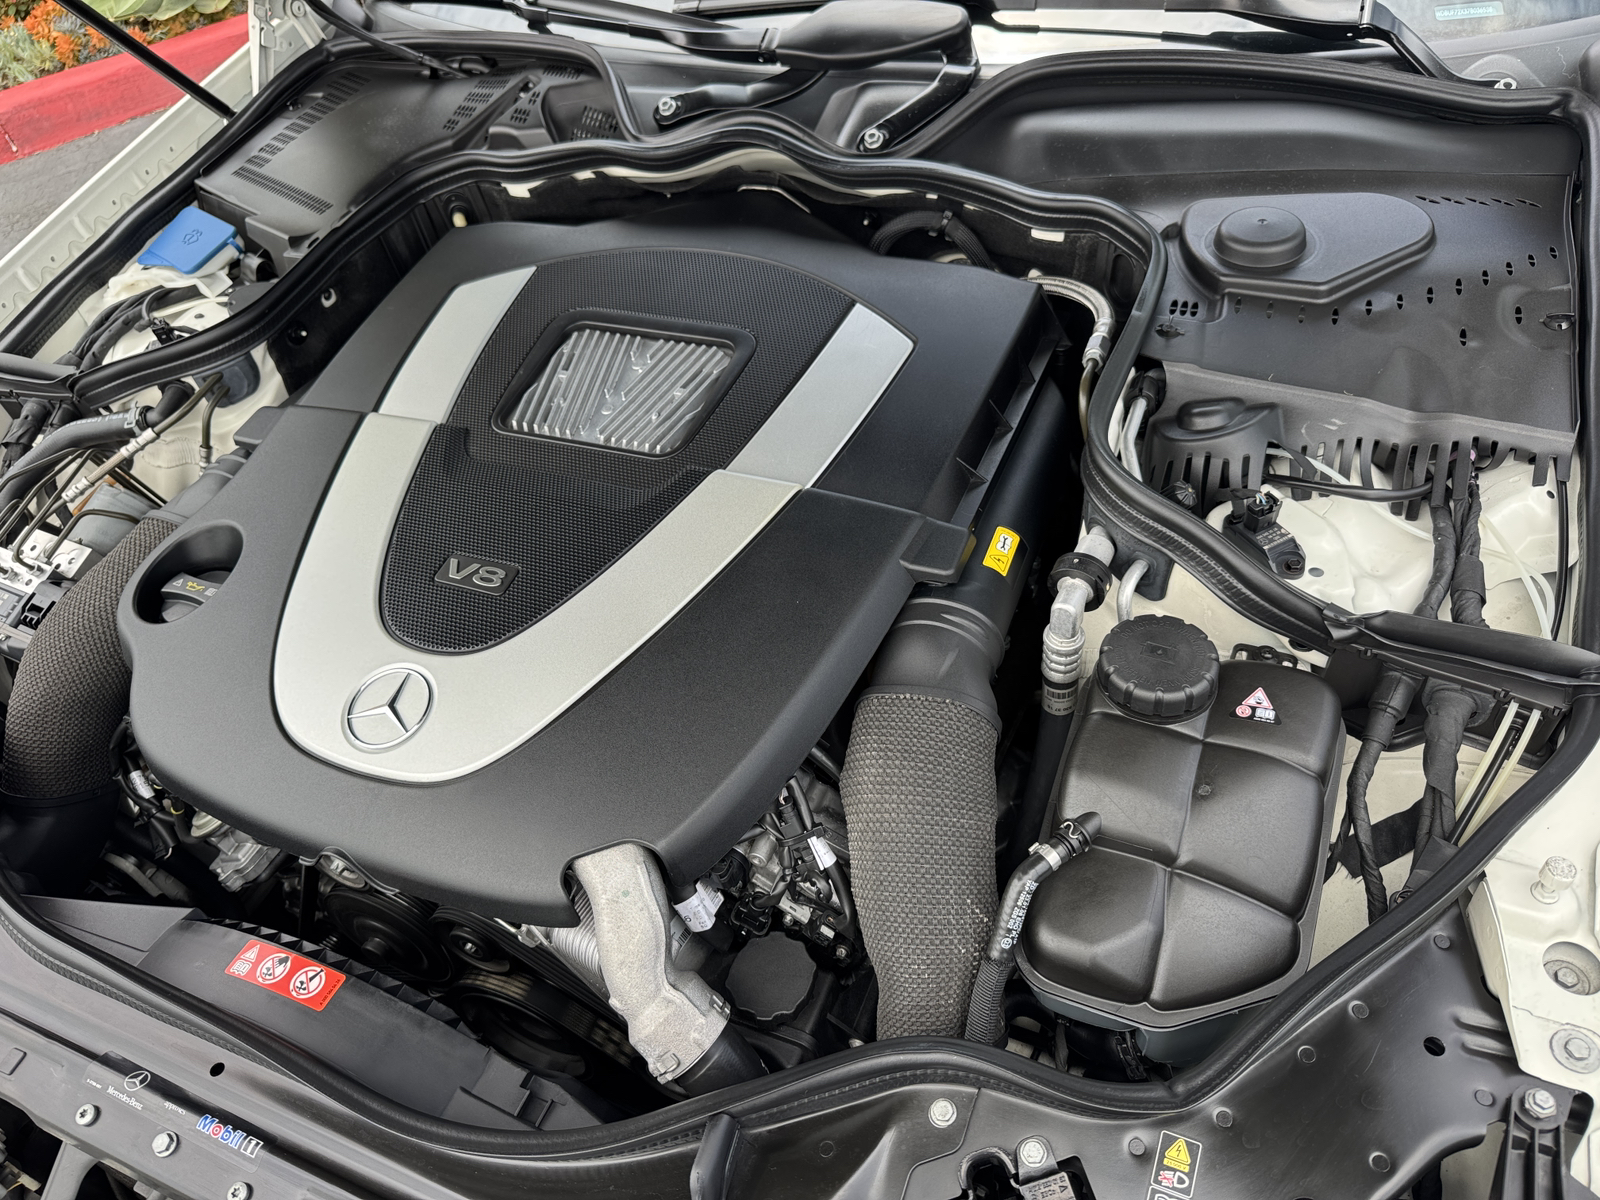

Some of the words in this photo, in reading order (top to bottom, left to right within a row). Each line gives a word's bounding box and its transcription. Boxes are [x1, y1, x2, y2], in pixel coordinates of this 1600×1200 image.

[449, 558, 506, 587] V8
[1121, 628, 1132, 638] DO
[1132, 620, 1150, 631] NOT
[1152, 620, 1176, 629] OPEN
[106, 1086, 143, 1110] Mercedes-Benz
[196, 1114, 245, 1148] Mobil
